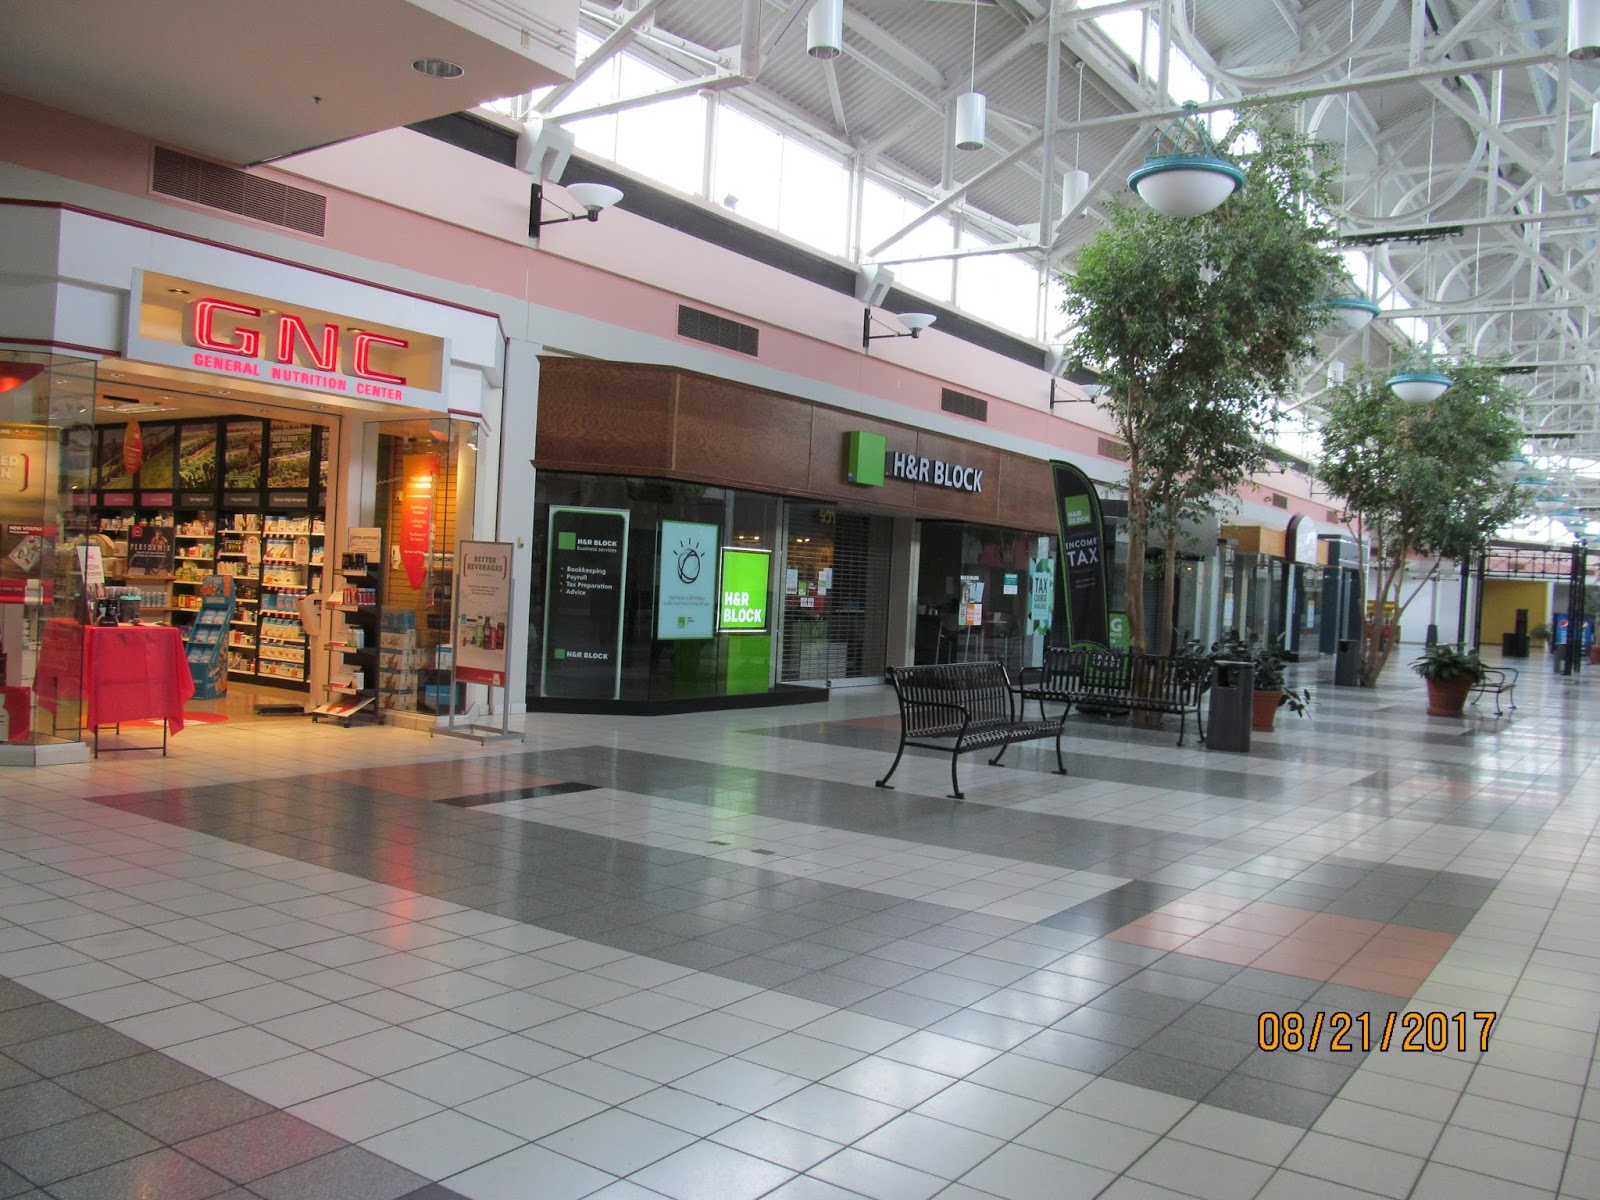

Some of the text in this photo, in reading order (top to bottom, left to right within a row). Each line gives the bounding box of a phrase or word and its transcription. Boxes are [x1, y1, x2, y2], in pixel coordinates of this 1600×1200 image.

[194, 297, 409, 386] GNC
[192, 353, 403, 401] GENERAL NUTRITION CENTER
[894, 452, 983, 492] H&R BLOCK
[1066, 538, 1097, 549] INCOME
[474, 556, 497, 564] BETTER
[1067, 548, 1098, 567] TAX
[467, 563, 503, 572] BEVERAGES
[566, 566, 606, 575] Bookkeeping
[1034, 578, 1048, 593] TAX
[724, 592, 750, 606] H&R
[723, 608, 763, 622] BLOCK
